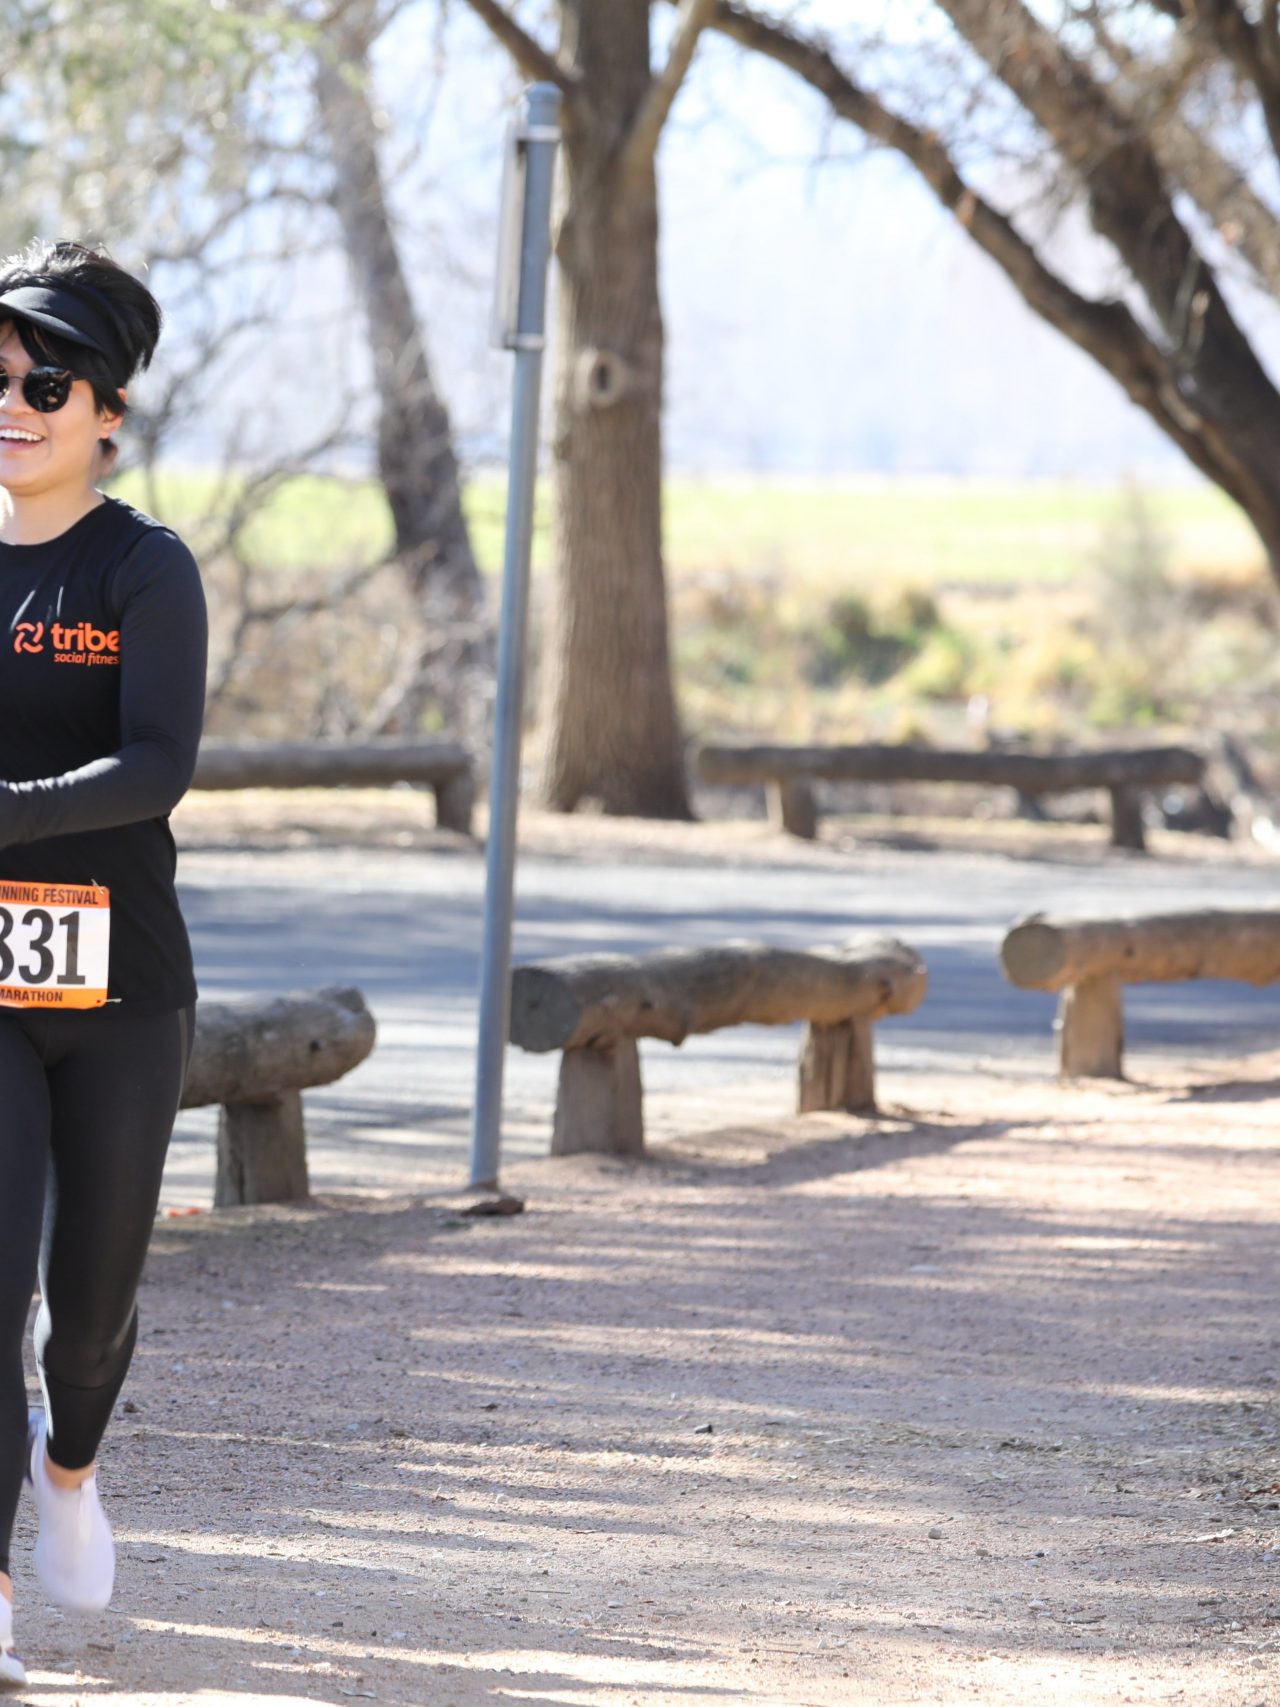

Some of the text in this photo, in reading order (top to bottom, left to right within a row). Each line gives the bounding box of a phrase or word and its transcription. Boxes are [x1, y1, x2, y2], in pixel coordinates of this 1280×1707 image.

[50, 622, 120, 652] tribe
[54, 652, 86, 664] social
[42, 888, 99, 905] FESTIVAL
